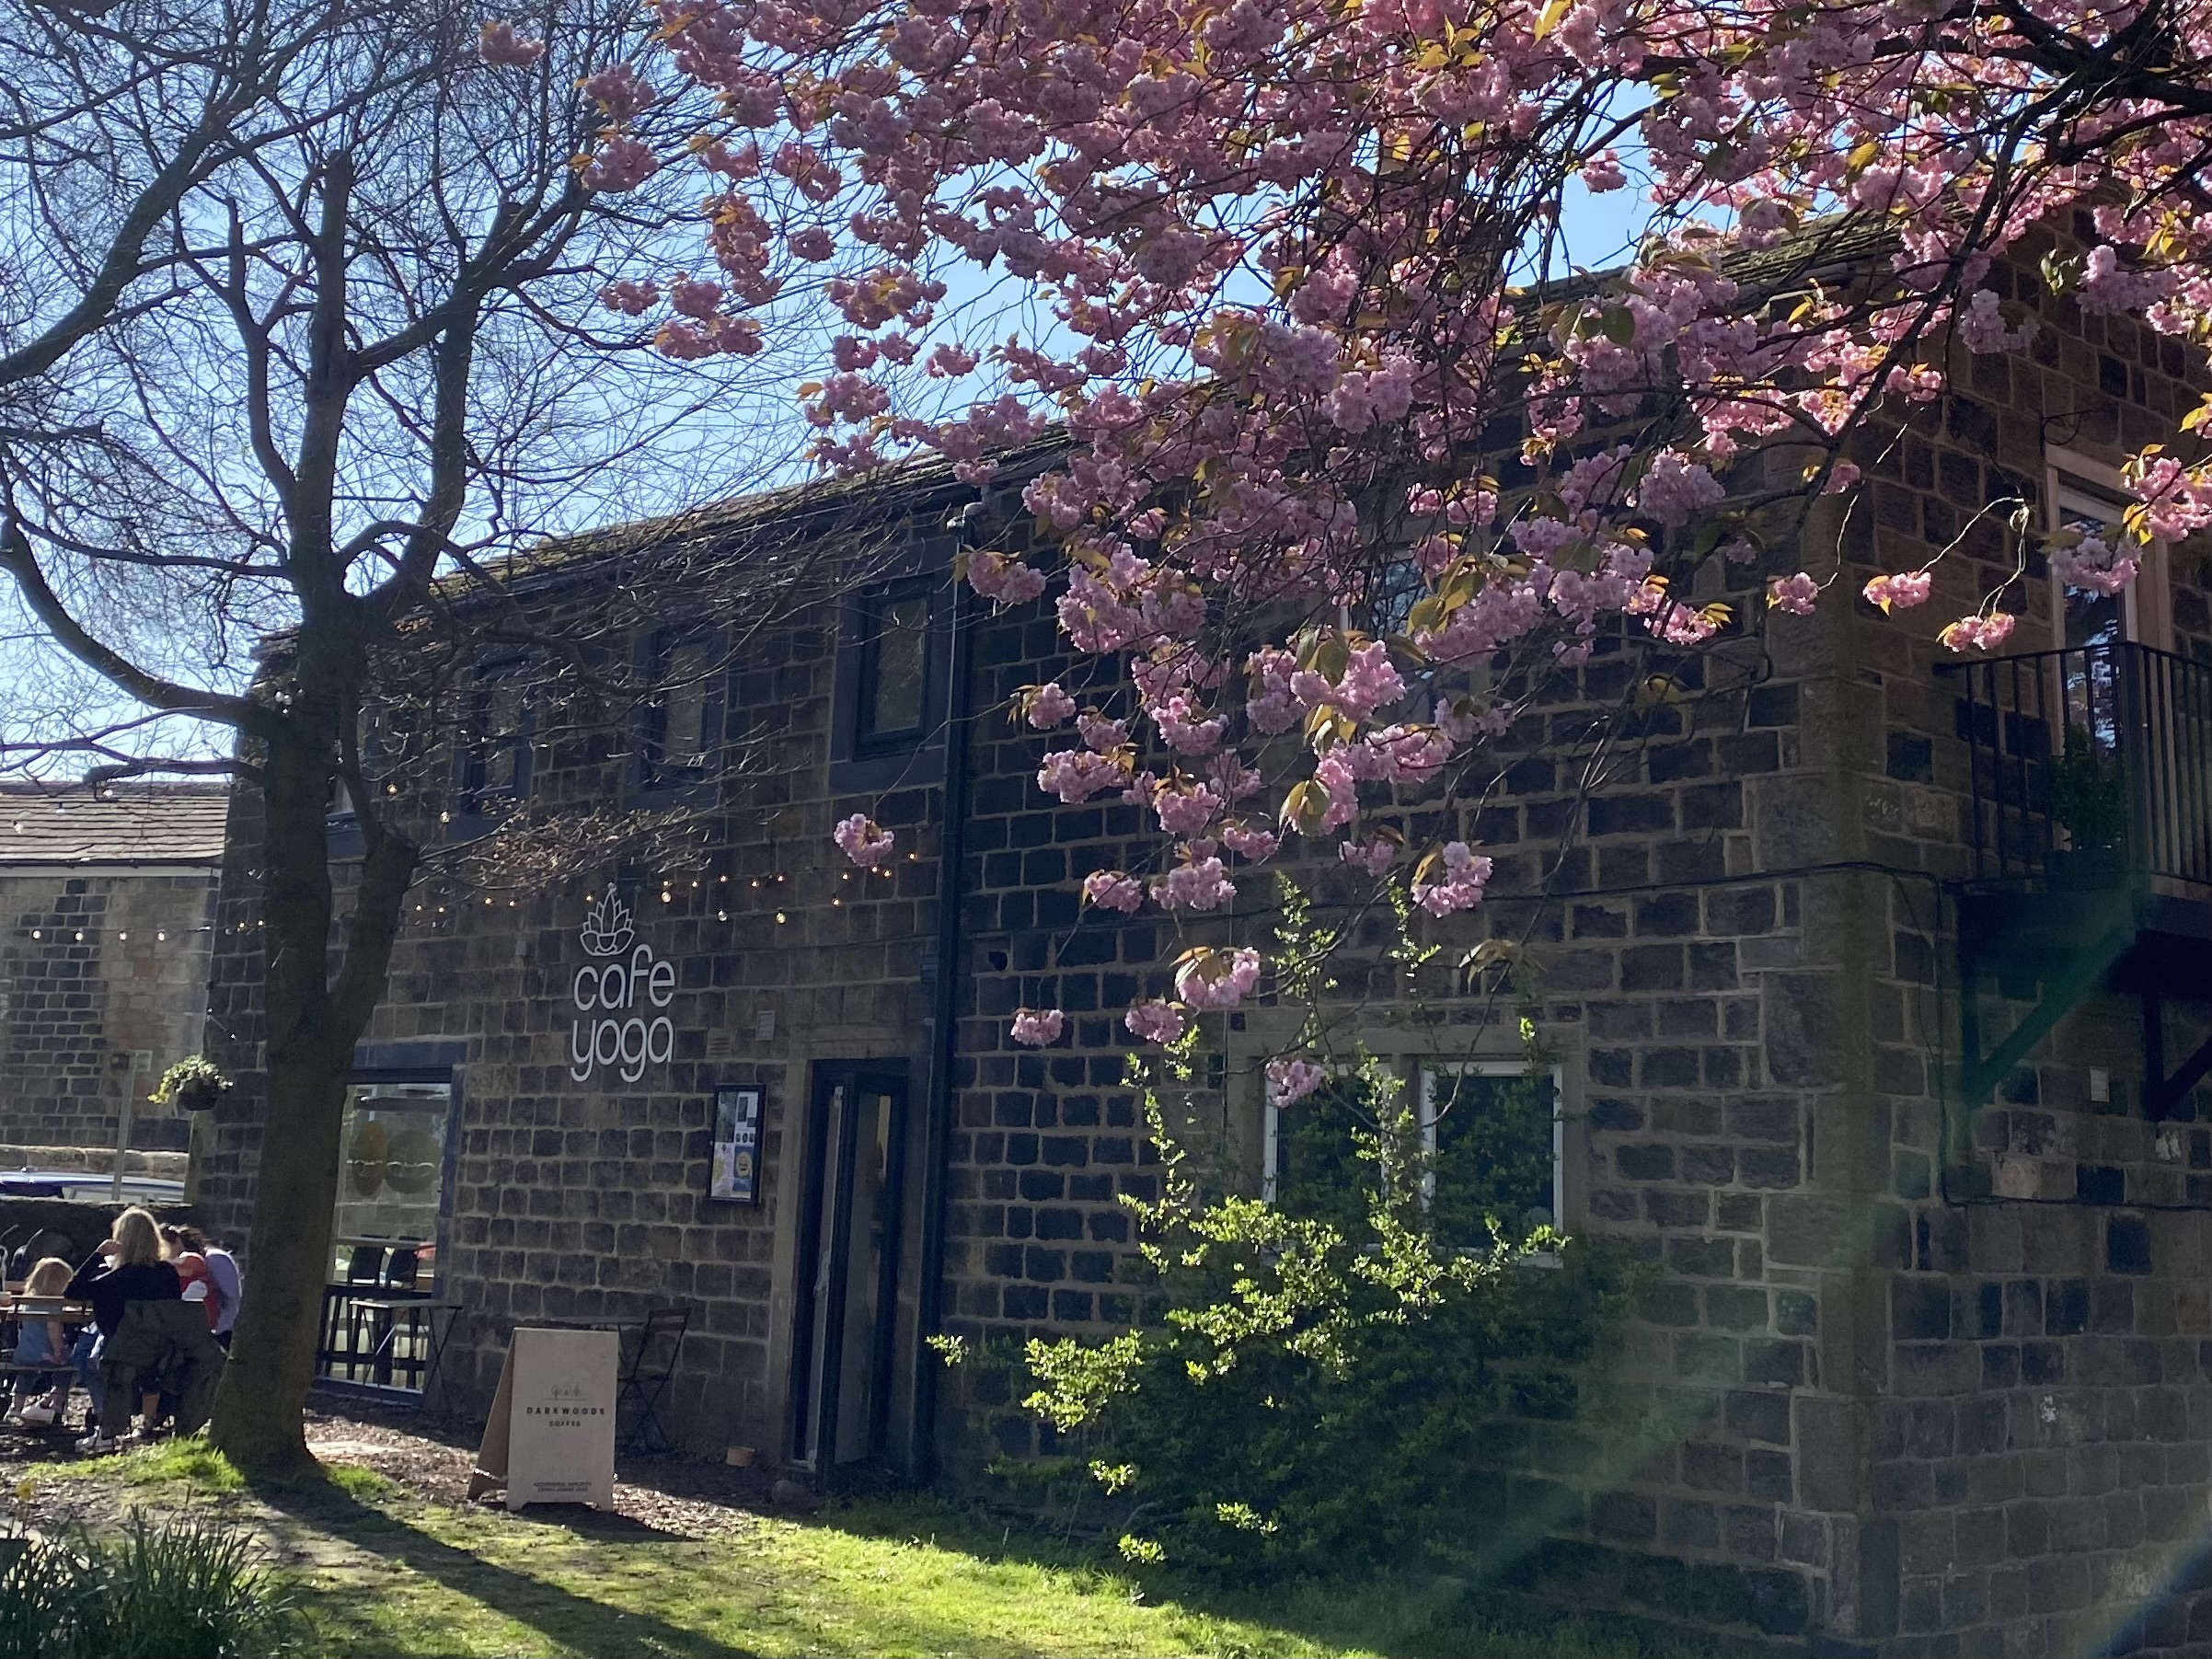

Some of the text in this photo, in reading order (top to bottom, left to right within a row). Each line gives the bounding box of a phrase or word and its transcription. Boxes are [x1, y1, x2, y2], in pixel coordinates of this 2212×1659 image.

[574, 944, 674, 1011] cafe
[570, 1016, 674, 1083] yoga
[526, 1407, 605, 1415] DARKWOODS
